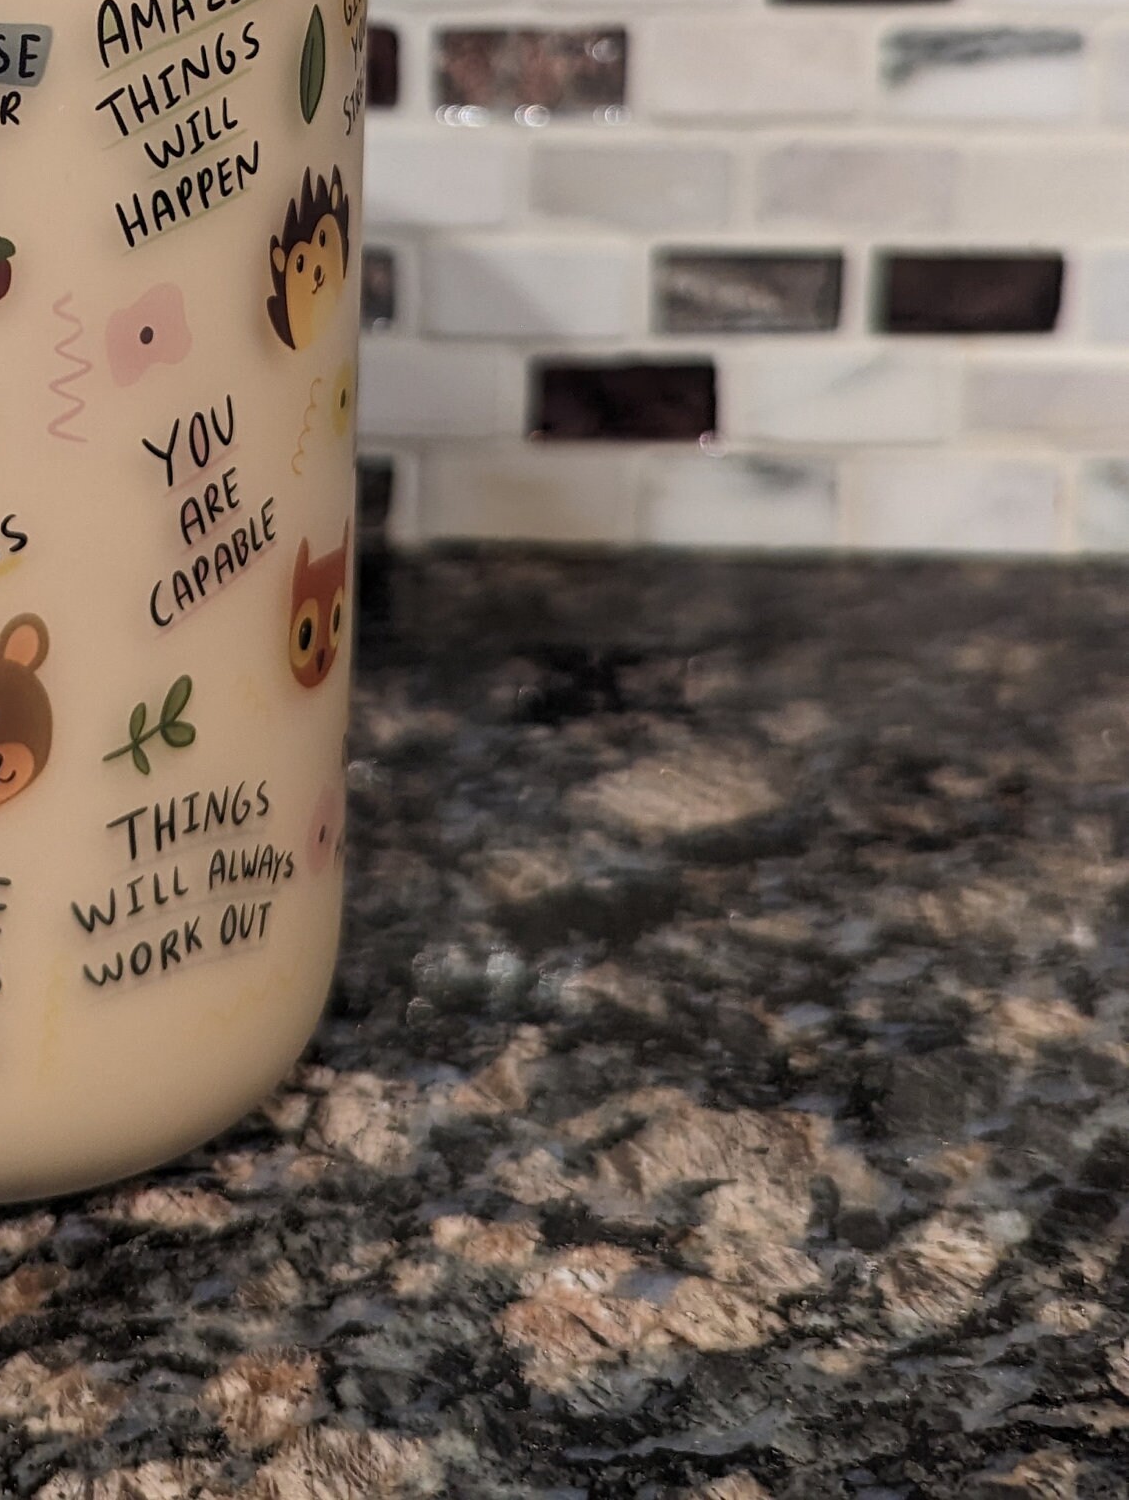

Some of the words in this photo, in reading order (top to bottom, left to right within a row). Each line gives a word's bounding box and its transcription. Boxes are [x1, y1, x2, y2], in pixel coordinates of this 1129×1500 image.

[95, 21, 260, 136] THINGS
[144, 97, 238, 169] WILL
[115, 140, 259, 247] HAPPEN
[142, 394, 235, 487] YOU
[180, 466, 240, 545] ARE
[150, 497, 276, 627] CAPABLE
[106, 780, 270, 860] THINGS
[71, 865, 189, 933] WILL
[208, 843, 295, 890] ALWAYS
[83, 916, 202, 986] WORK
[220, 901, 272, 945] OUT
